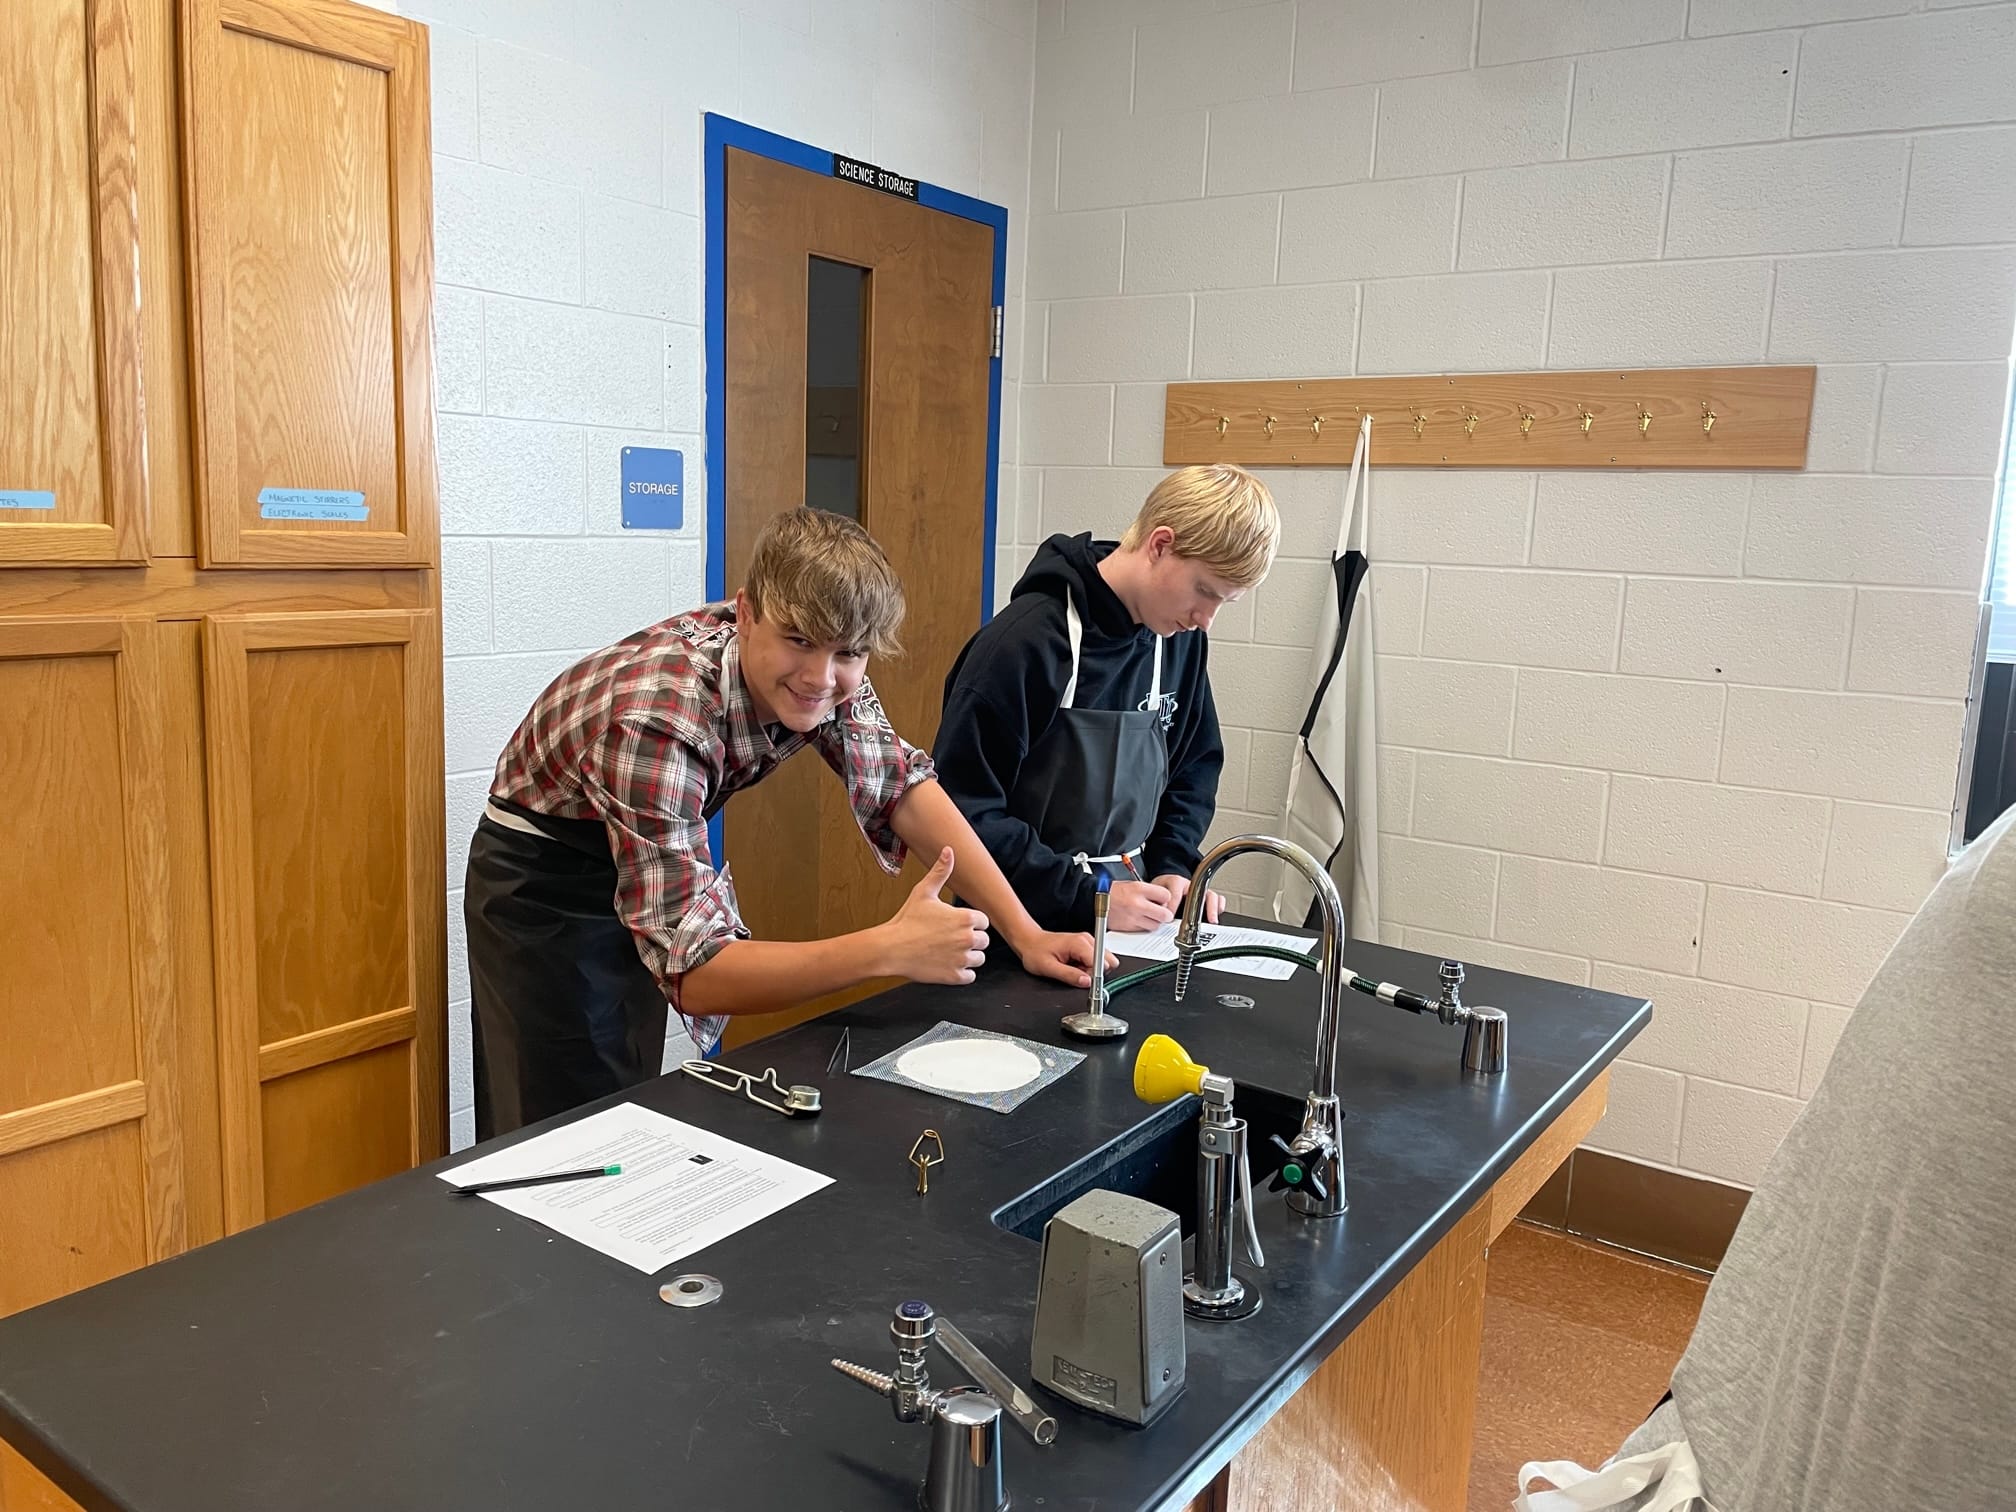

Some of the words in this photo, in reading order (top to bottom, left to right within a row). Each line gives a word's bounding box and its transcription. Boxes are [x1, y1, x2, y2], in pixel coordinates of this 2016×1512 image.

[839, 160, 875, 185] SCIENCE
[878, 172, 914, 197] STORAGE
[628, 481, 679, 496] STORAGE
